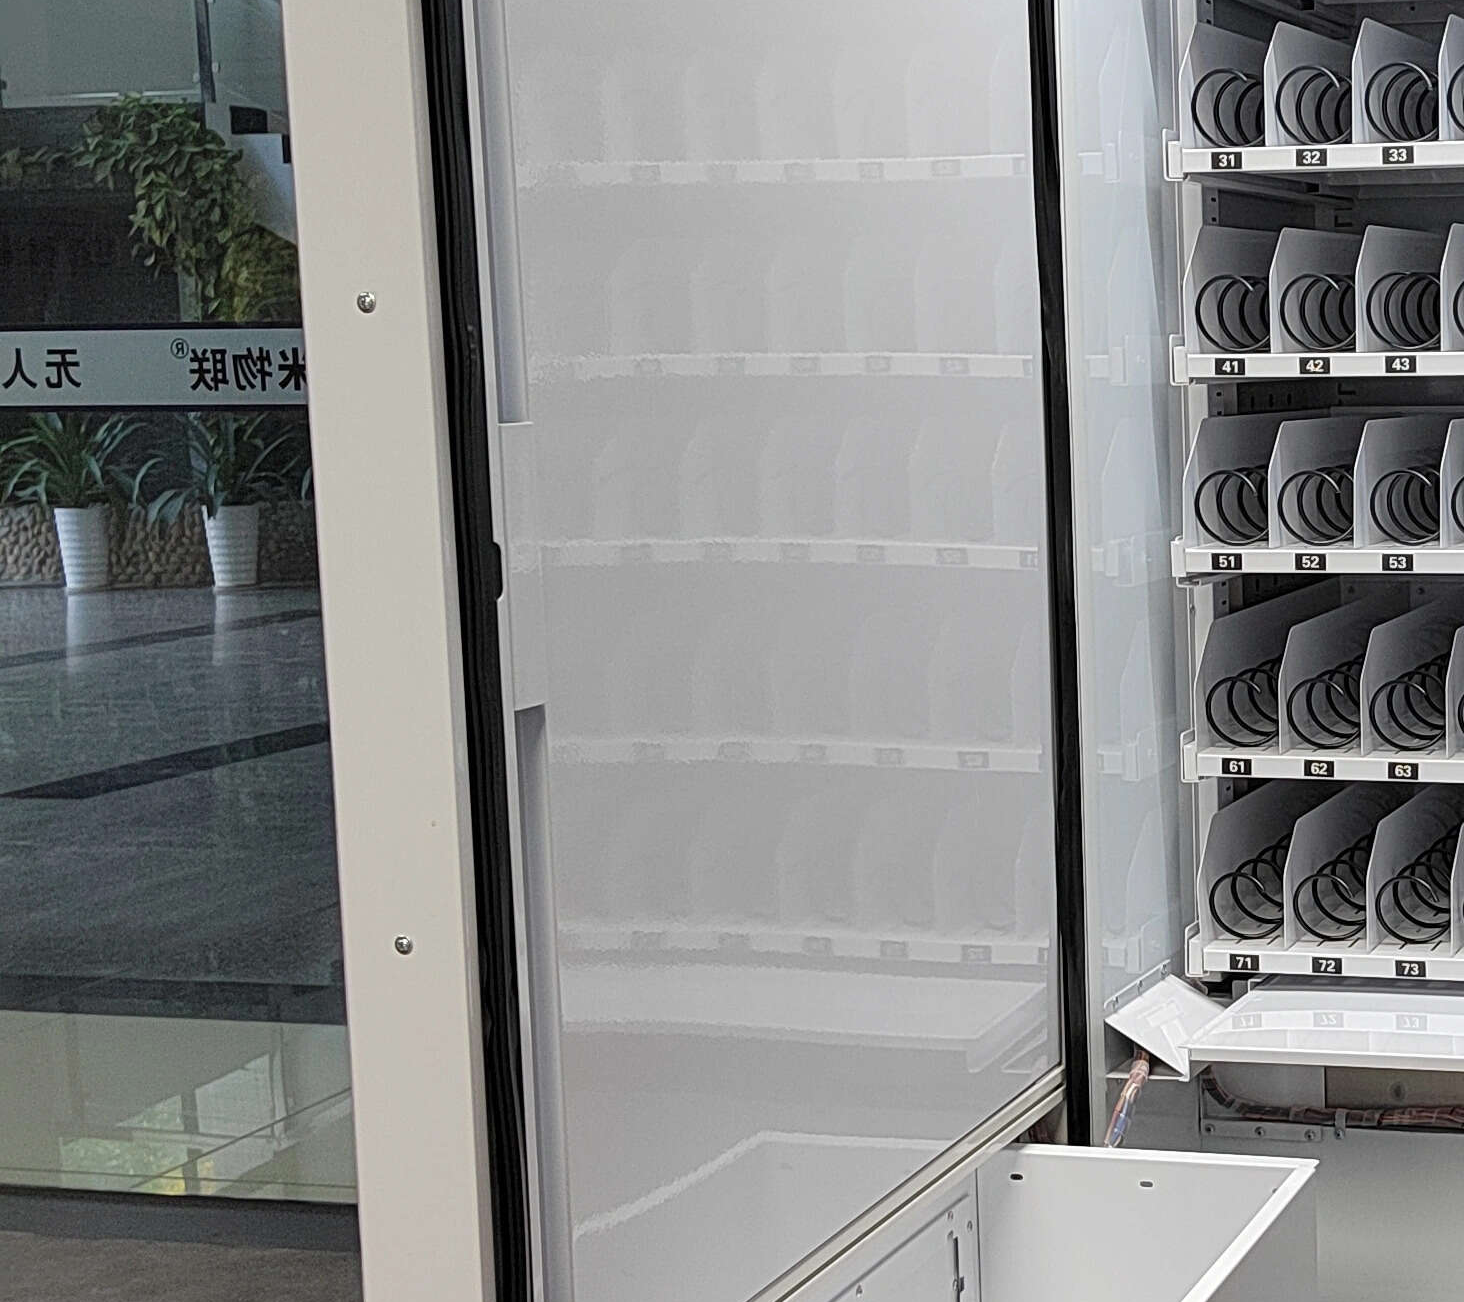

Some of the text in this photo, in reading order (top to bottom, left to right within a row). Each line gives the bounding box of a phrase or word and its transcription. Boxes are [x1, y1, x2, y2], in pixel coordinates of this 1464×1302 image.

[1218, 153, 1235, 168] 31
[1302, 150, 1321, 165] 32
[1388, 148, 1408, 162] 33
[1221, 360, 1239, 374] 41
[1305, 359, 1324, 373] 42
[1391, 357, 1410, 371] 43
[1218, 555, 1235, 569] 51
[1301, 555, 1320, 569] 52
[1388, 556, 1407, 569] 53
[1229, 760, 1245, 774] 61
[1310, 762, 1328, 776] 62
[1394, 764, 1412, 778] 63
[1235, 956, 1252, 969] 71
[1318, 959, 1336, 973] 72
[1401, 962, 1420, 976] 73
